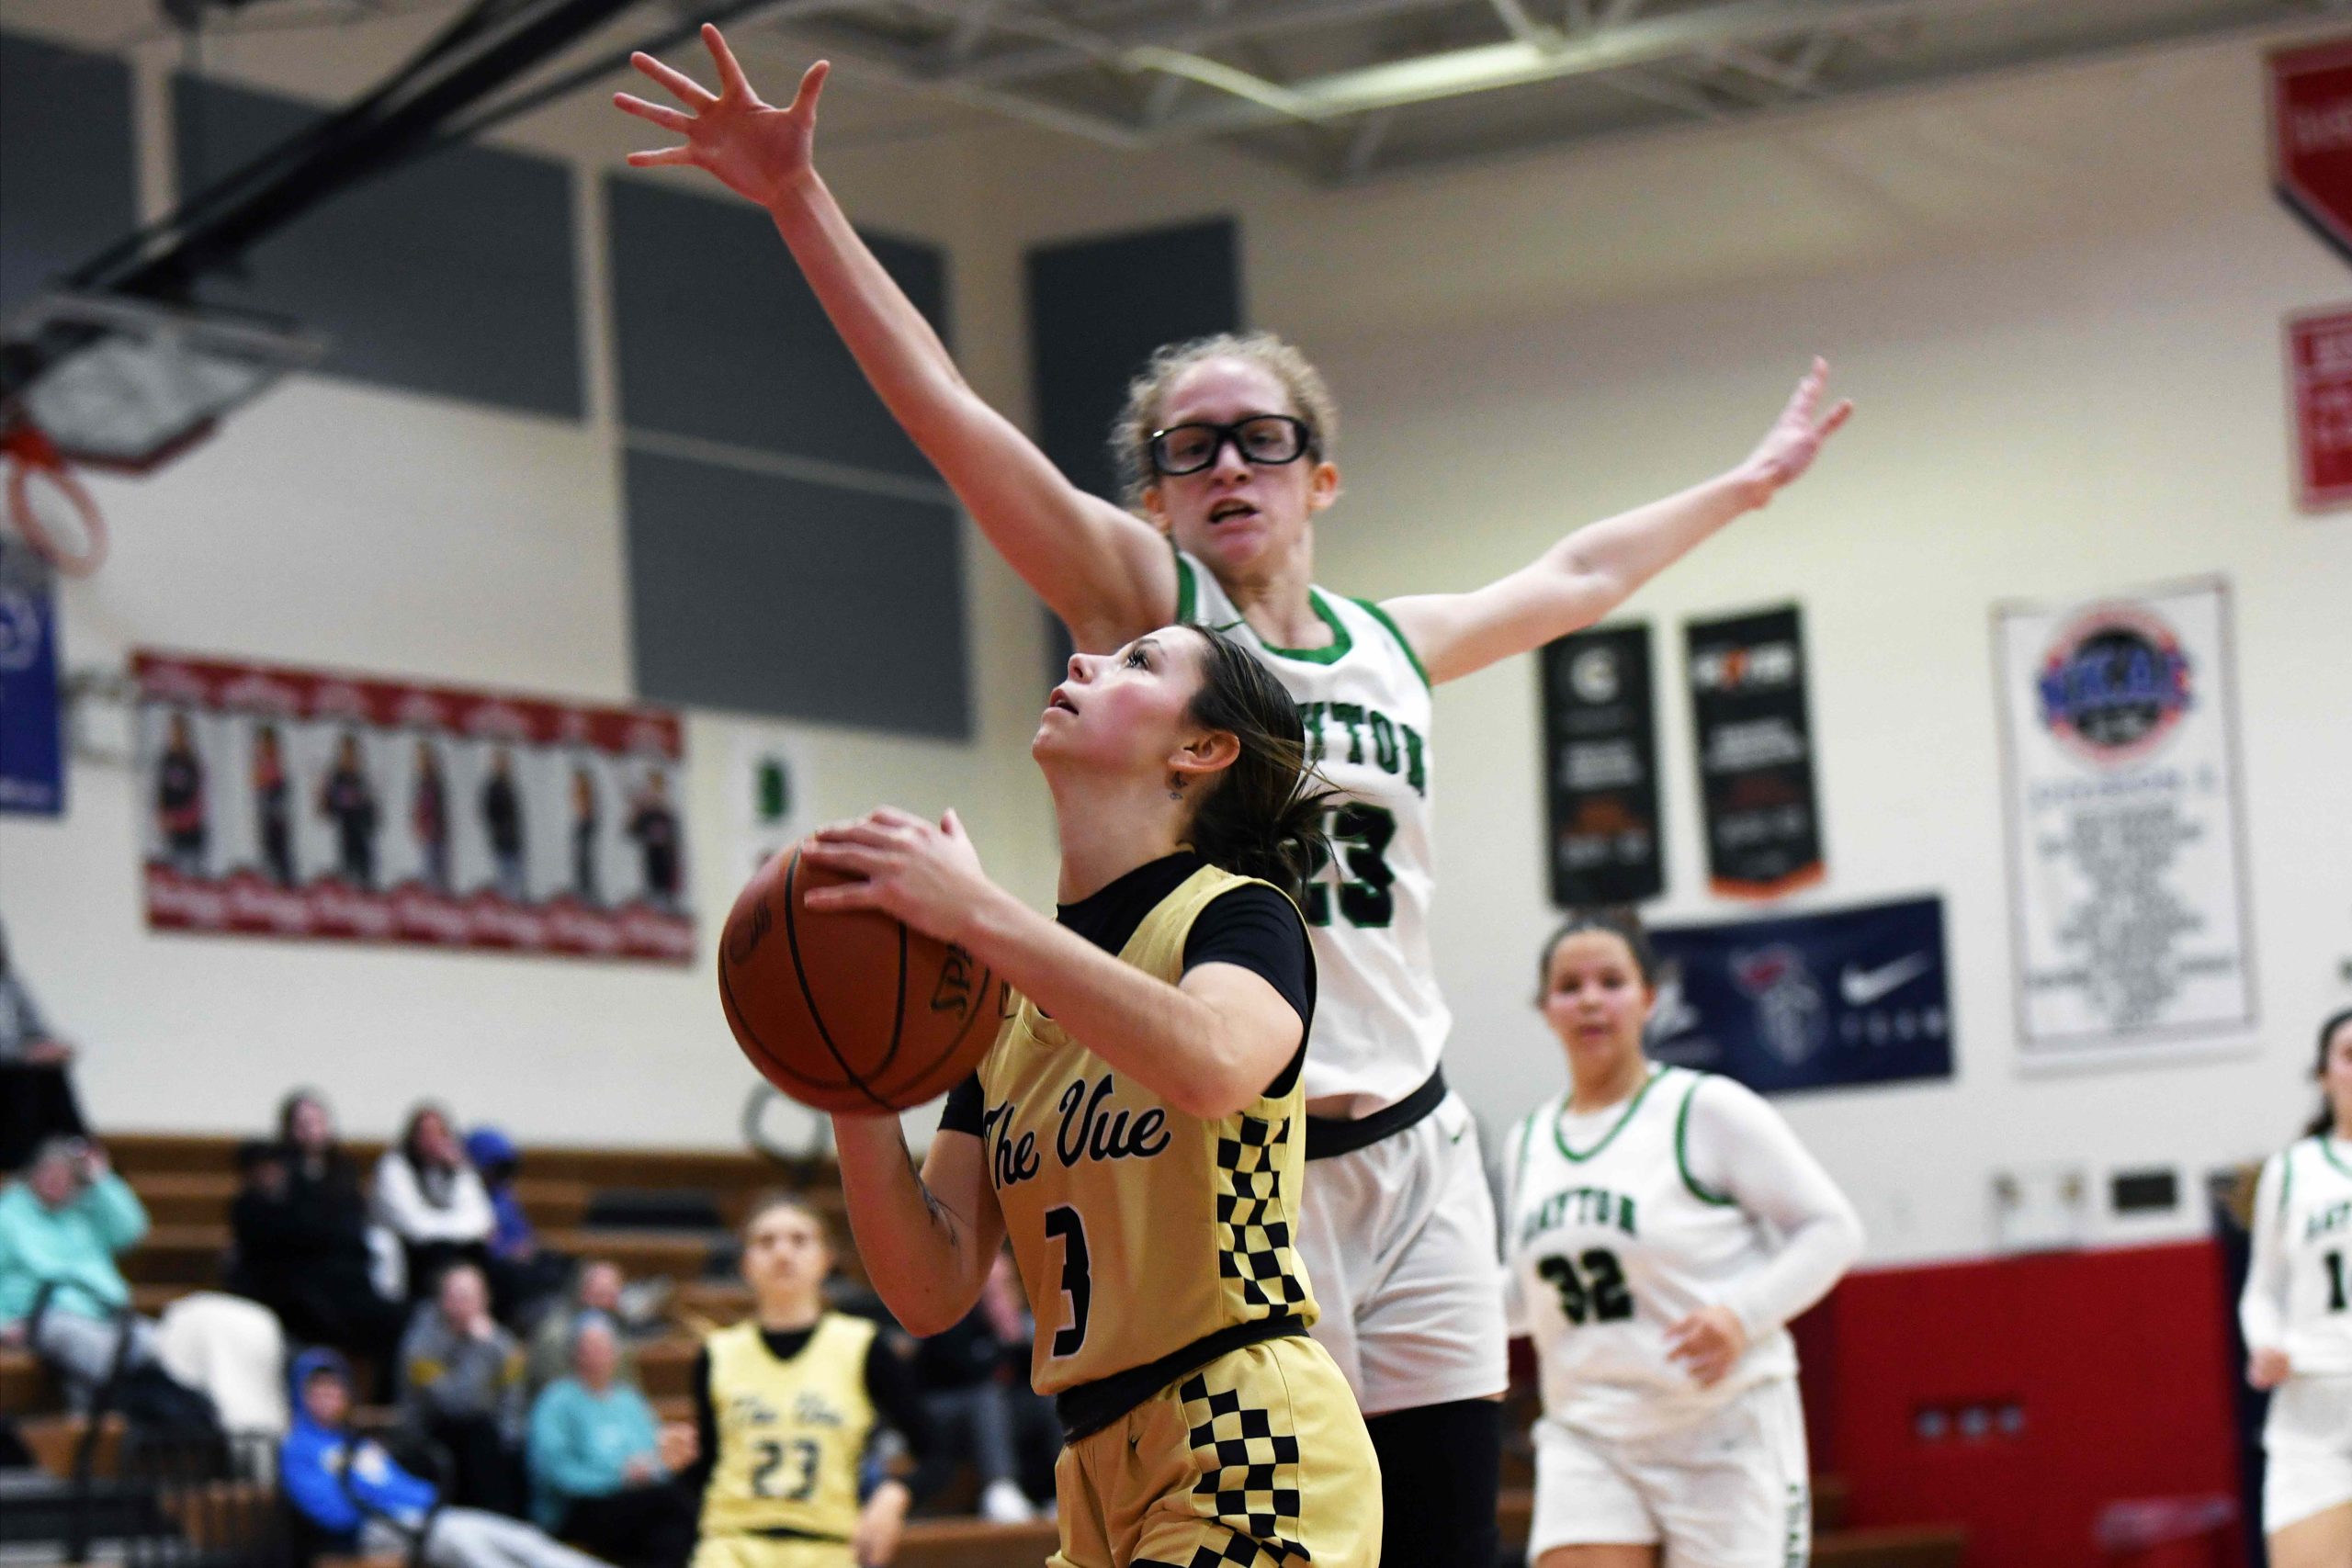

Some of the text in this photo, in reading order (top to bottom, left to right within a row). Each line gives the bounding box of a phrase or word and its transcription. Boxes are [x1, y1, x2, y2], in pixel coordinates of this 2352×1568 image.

[1294, 702, 1426, 798] YTON
[984, 1073, 1172, 1190] The Vue
[1045, 1204, 1092, 1359] 3
[1536, 1249, 1634, 1325] 32
[751, 1437, 820, 1501] 23
